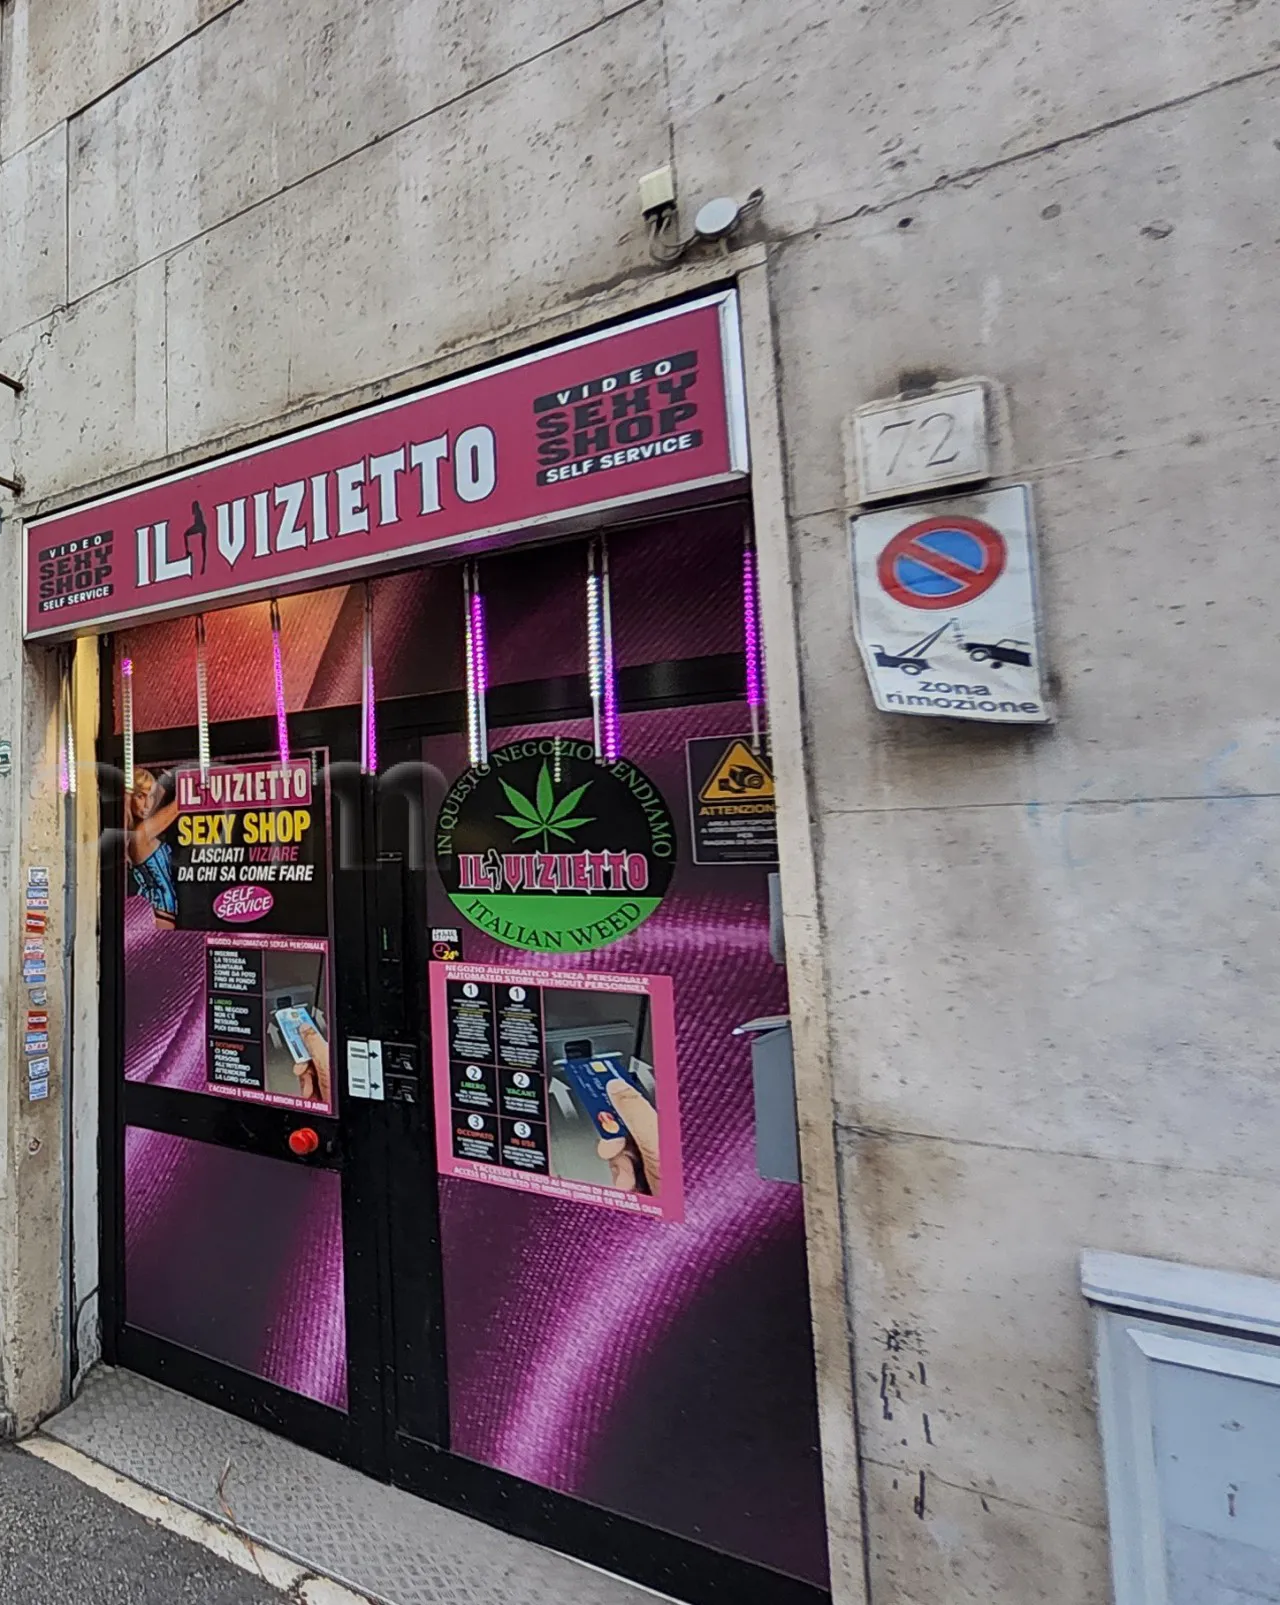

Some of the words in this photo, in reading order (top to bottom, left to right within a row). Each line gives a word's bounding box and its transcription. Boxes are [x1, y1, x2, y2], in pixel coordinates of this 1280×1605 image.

[556, 360, 671, 405] VIDEO
[537, 403, 698, 465] SHOP
[878, 411, 962, 477] 72
[546, 459, 594, 483] SELF
[600, 433, 692, 469] SERVICE
[136, 520, 194, 588] IL
[216, 425, 498, 569] VIZIETTO
[49, 535, 102, 558] VIDEO
[39, 565, 112, 599] SHOP
[43, 597, 66, 611] SELF
[67, 586, 110, 605] SERVICE
[918, 680, 991, 697] zona
[886, 689, 1041, 715] rimozione
[493, 740, 594, 767] NEGOZIO
[179, 777, 201, 805] IL
[210, 768, 308, 804] VIZIETTO
[440, 765, 491, 830] QUESTO
[699, 804, 776, 816] ATTENZION
[177, 813, 236, 846] SEXY
[242, 810, 311, 843] SHOP
[191, 847, 244, 864] LASCIATI
[248, 846, 300, 862] VIZIARE
[437, 835, 453, 857] IN
[177, 865, 195, 882] DA
[196, 865, 218, 882] CHI
[220, 865, 236, 881] SA
[239, 864, 277, 881] COME
[279, 864, 314, 881] FARE
[458, 853, 494, 893] IL
[503, 849, 649, 895] VIZIETTO
[216, 896, 271, 918] SERVICE
[222, 886, 254, 904] SELF
[466, 899, 561, 948] ITALIAN
[569, 902, 641, 949] WEED
[445, 965, 485, 974] NEGOZIO
[487, 968, 548, 977] AUTOMATICO
[471, 1068, 478, 1079] 2
[517, 1074, 525, 1086] 2
[472, 1116, 480, 1128] 3
[518, 1124, 526, 1136] 3
